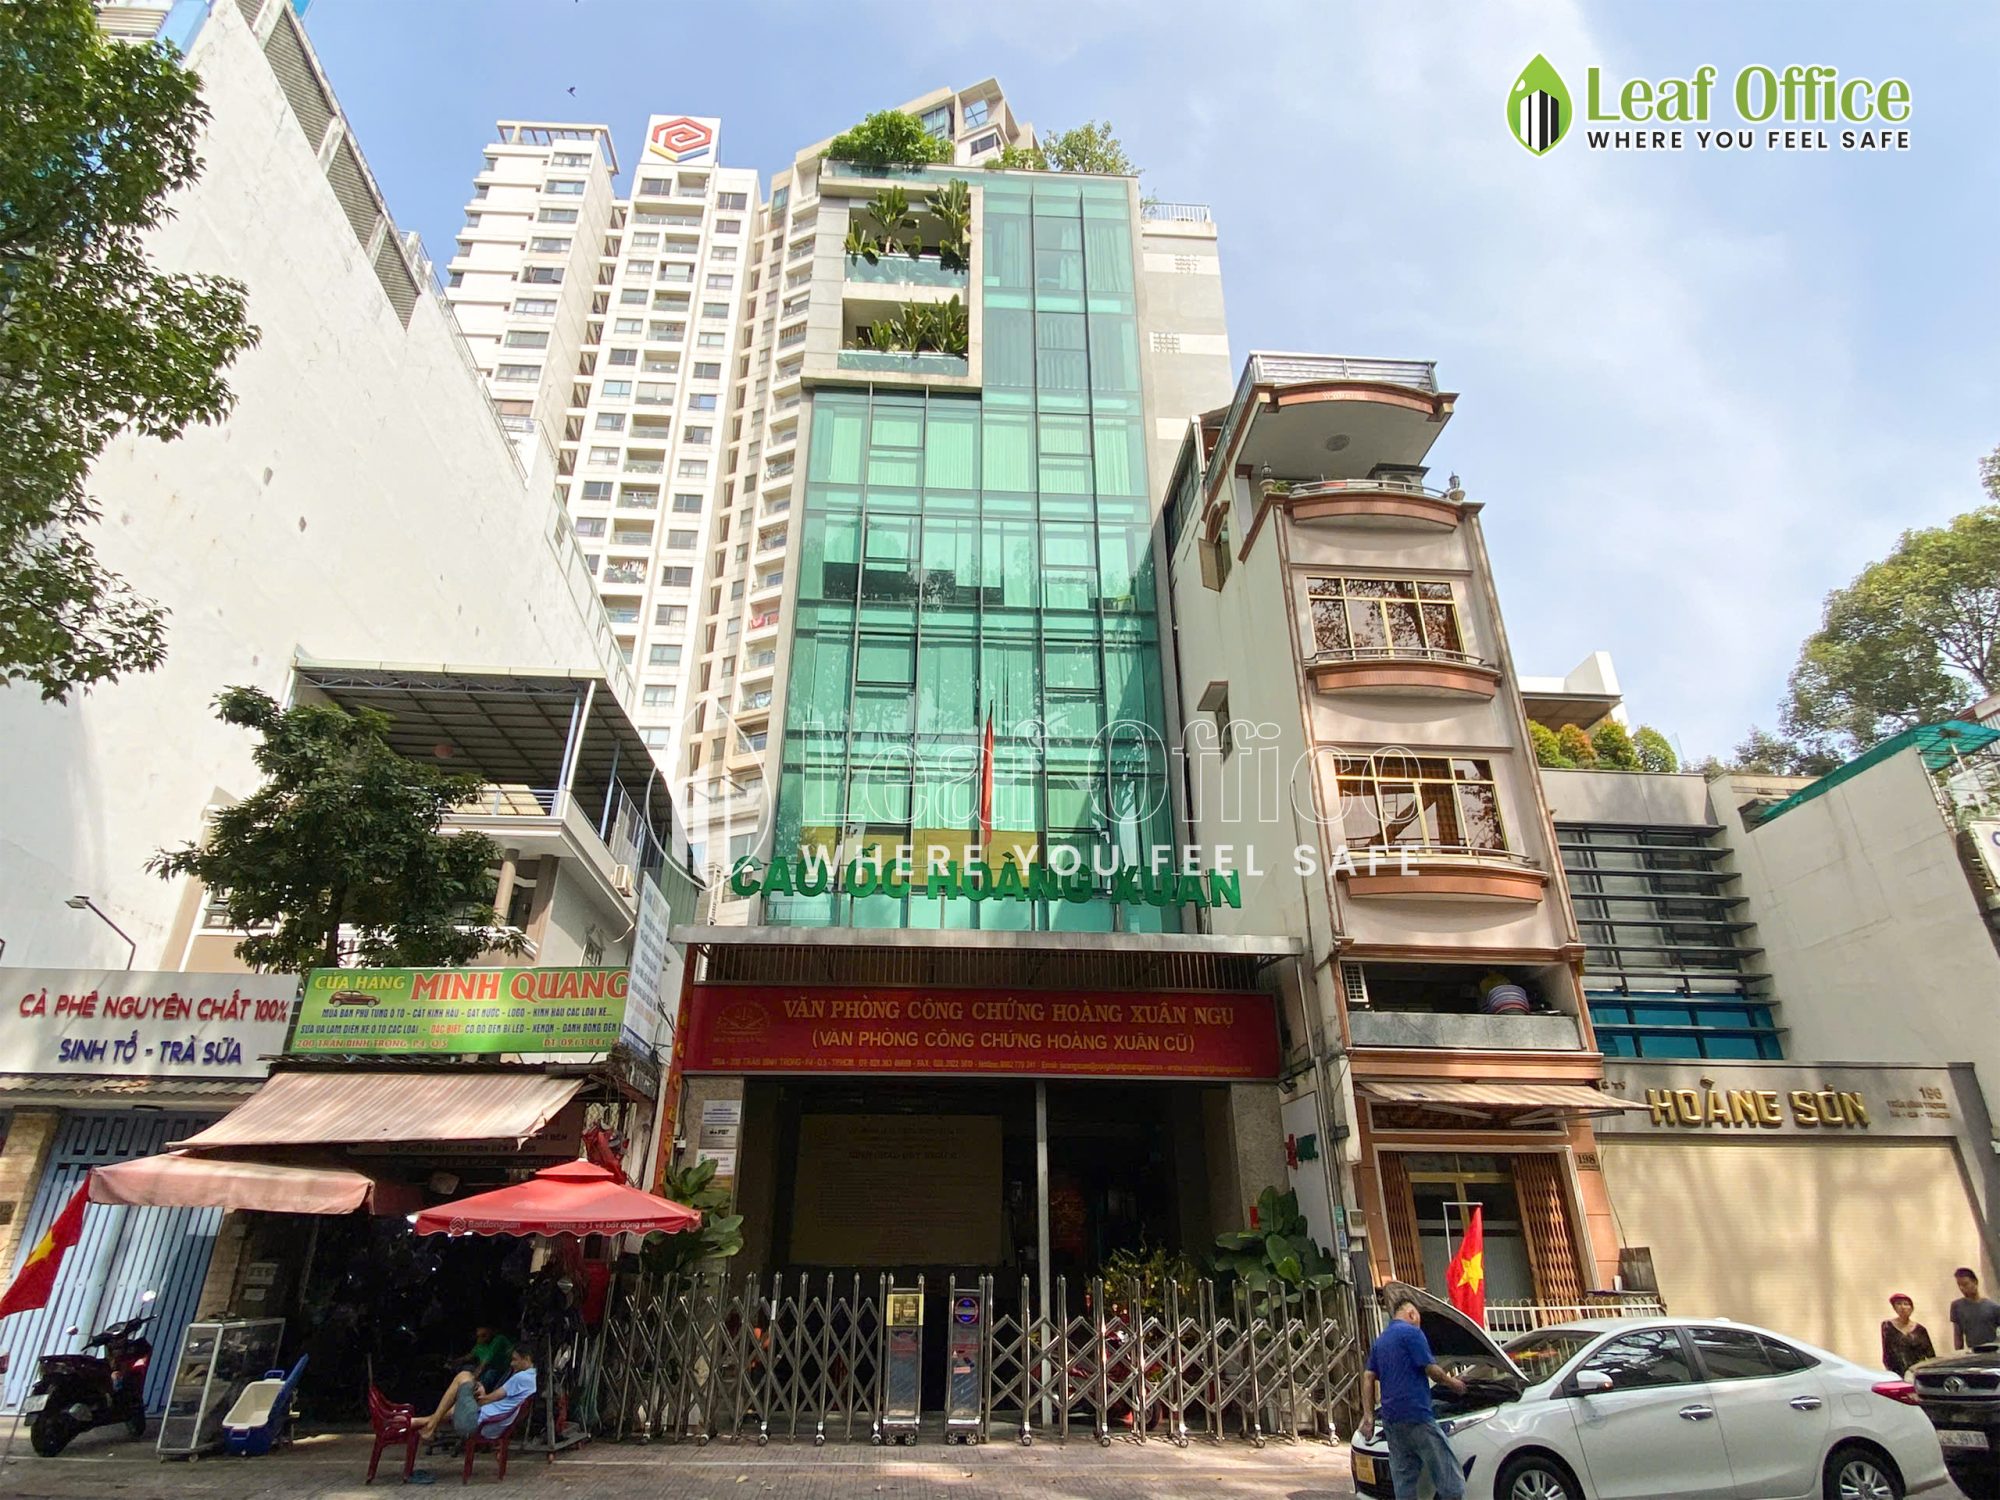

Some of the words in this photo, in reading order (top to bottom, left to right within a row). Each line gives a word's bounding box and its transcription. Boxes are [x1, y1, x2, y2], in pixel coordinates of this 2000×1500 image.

[731, 856, 828, 897] CAO
[411, 972, 502, 1001] MINH
[510, 971, 629, 1003] QUANG
[20, 987, 47, 1017] CÀ
[54, 990, 98, 1018] PHÊ
[103, 993, 193, 1020] NGUYÊN
[197, 989, 251, 1021] CHẤT
[254, 999, 288, 1022] 100%
[830, 995, 900, 1020] PHÒNG
[907, 999, 963, 1020] CÔNG
[1053, 1000, 1122, 1023] HOÀNG
[1130, 1002, 1187, 1024] XUÂN
[58, 1038, 108, 1063] SINH
[113, 1030, 138, 1064] TỐ
[160, 1035, 195, 1064] TRÀ
[202, 1037, 242, 1065] SỮA
[925, 1028, 974, 1047] CÔNG
[1047, 1030, 1106, 1050] HOÀNG
[1114, 1032, 1159, 1050] XUÂN
[1646, 1077, 1784, 1128] HOÀNG
[1577, 1154, 1596, 1164] 198
